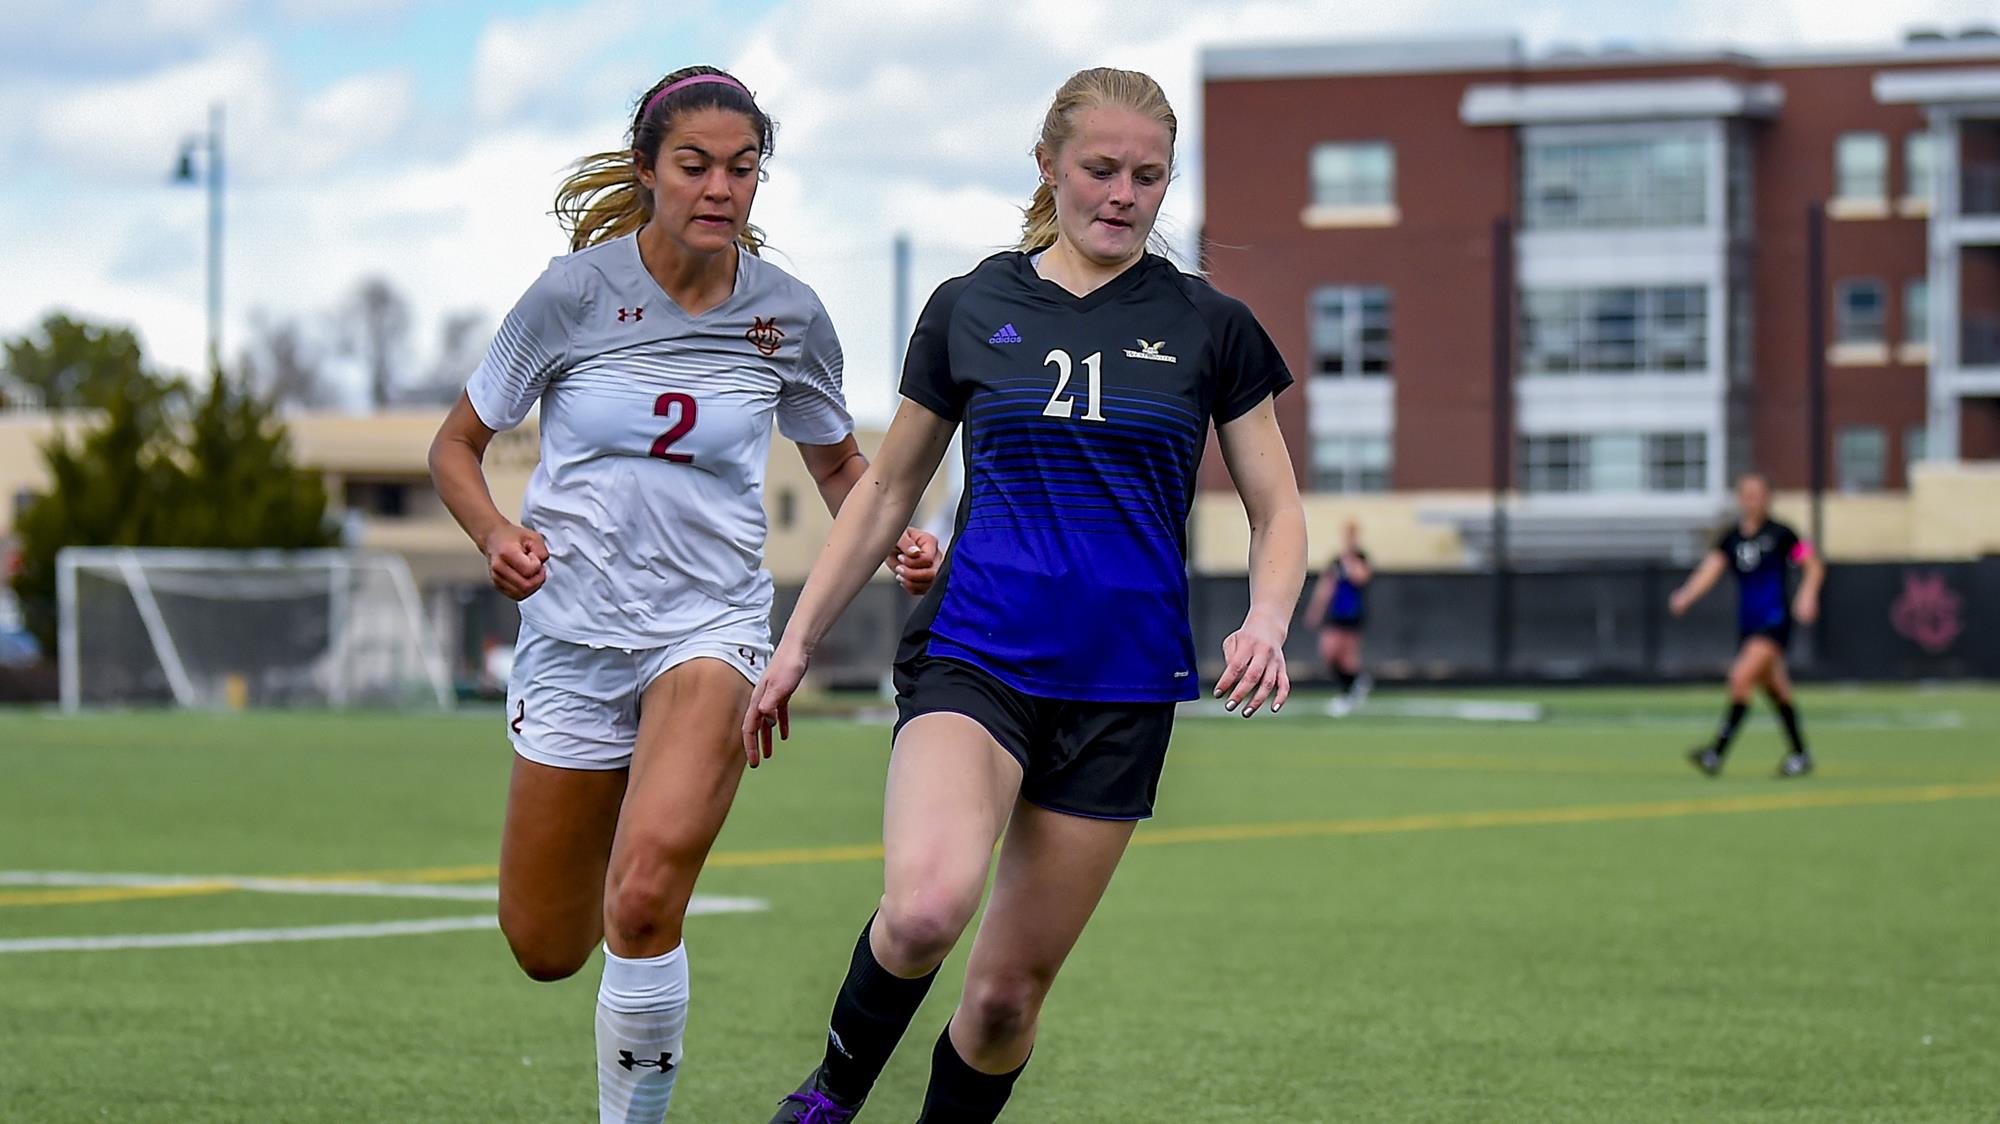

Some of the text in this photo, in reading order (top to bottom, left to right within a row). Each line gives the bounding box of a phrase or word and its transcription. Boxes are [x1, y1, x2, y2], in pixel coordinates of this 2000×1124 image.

[989, 335, 1022, 344] adidas
[1042, 349, 1107, 422] 21
[649, 392, 699, 464] 2
[511, 699, 525, 735] 2
